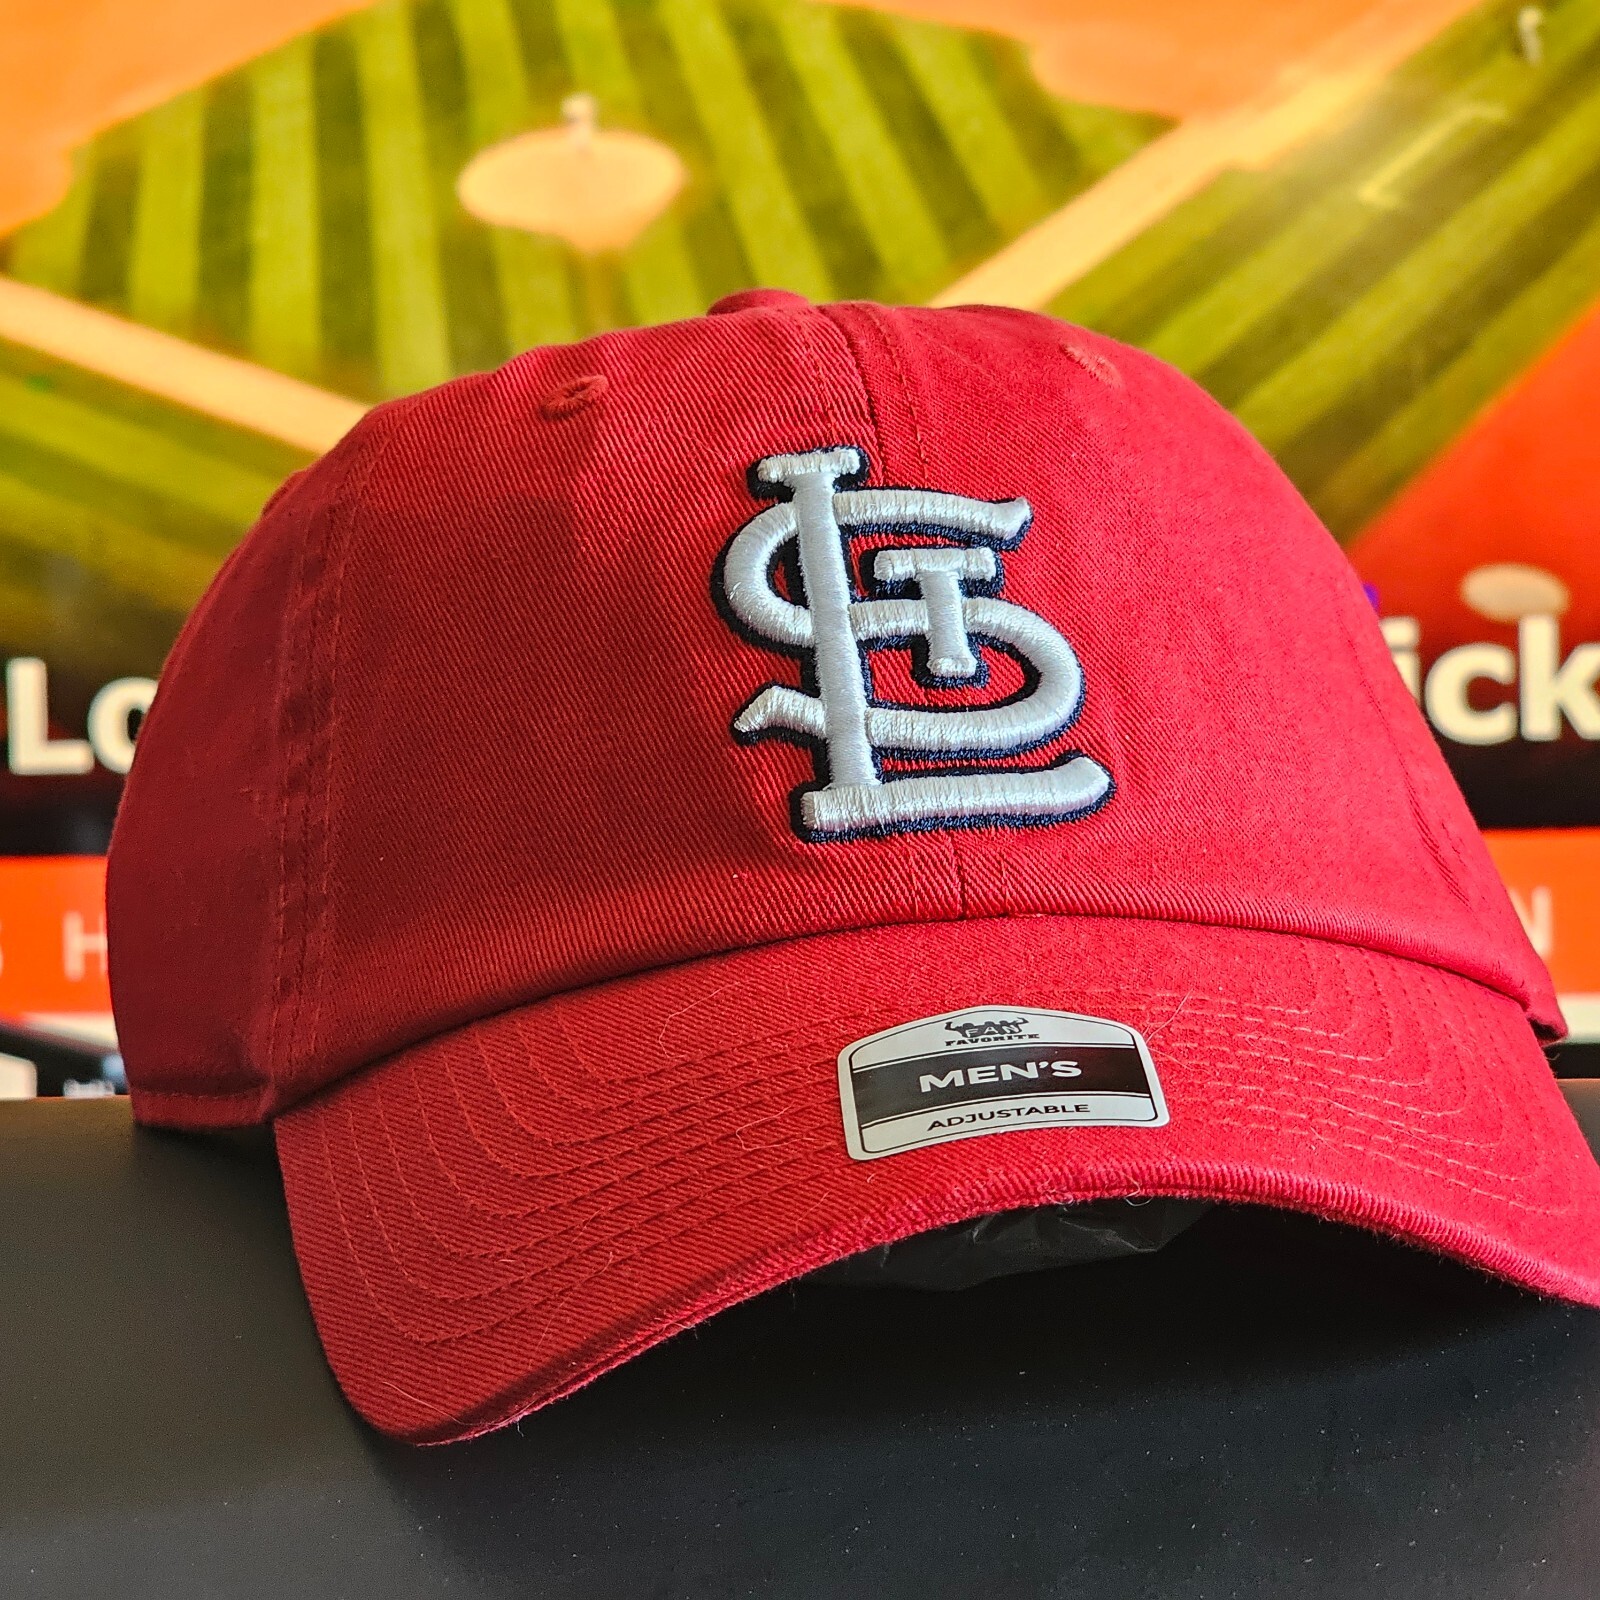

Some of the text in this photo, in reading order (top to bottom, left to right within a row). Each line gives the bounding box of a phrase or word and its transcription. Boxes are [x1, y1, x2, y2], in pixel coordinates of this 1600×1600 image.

[944, 1033, 1040, 1046] FAVORITE
[965, 1025, 1019, 1038] FAN
[919, 1060, 1082, 1093] MEN'S
[927, 1103, 1090, 1131] ADJUSTABLE
